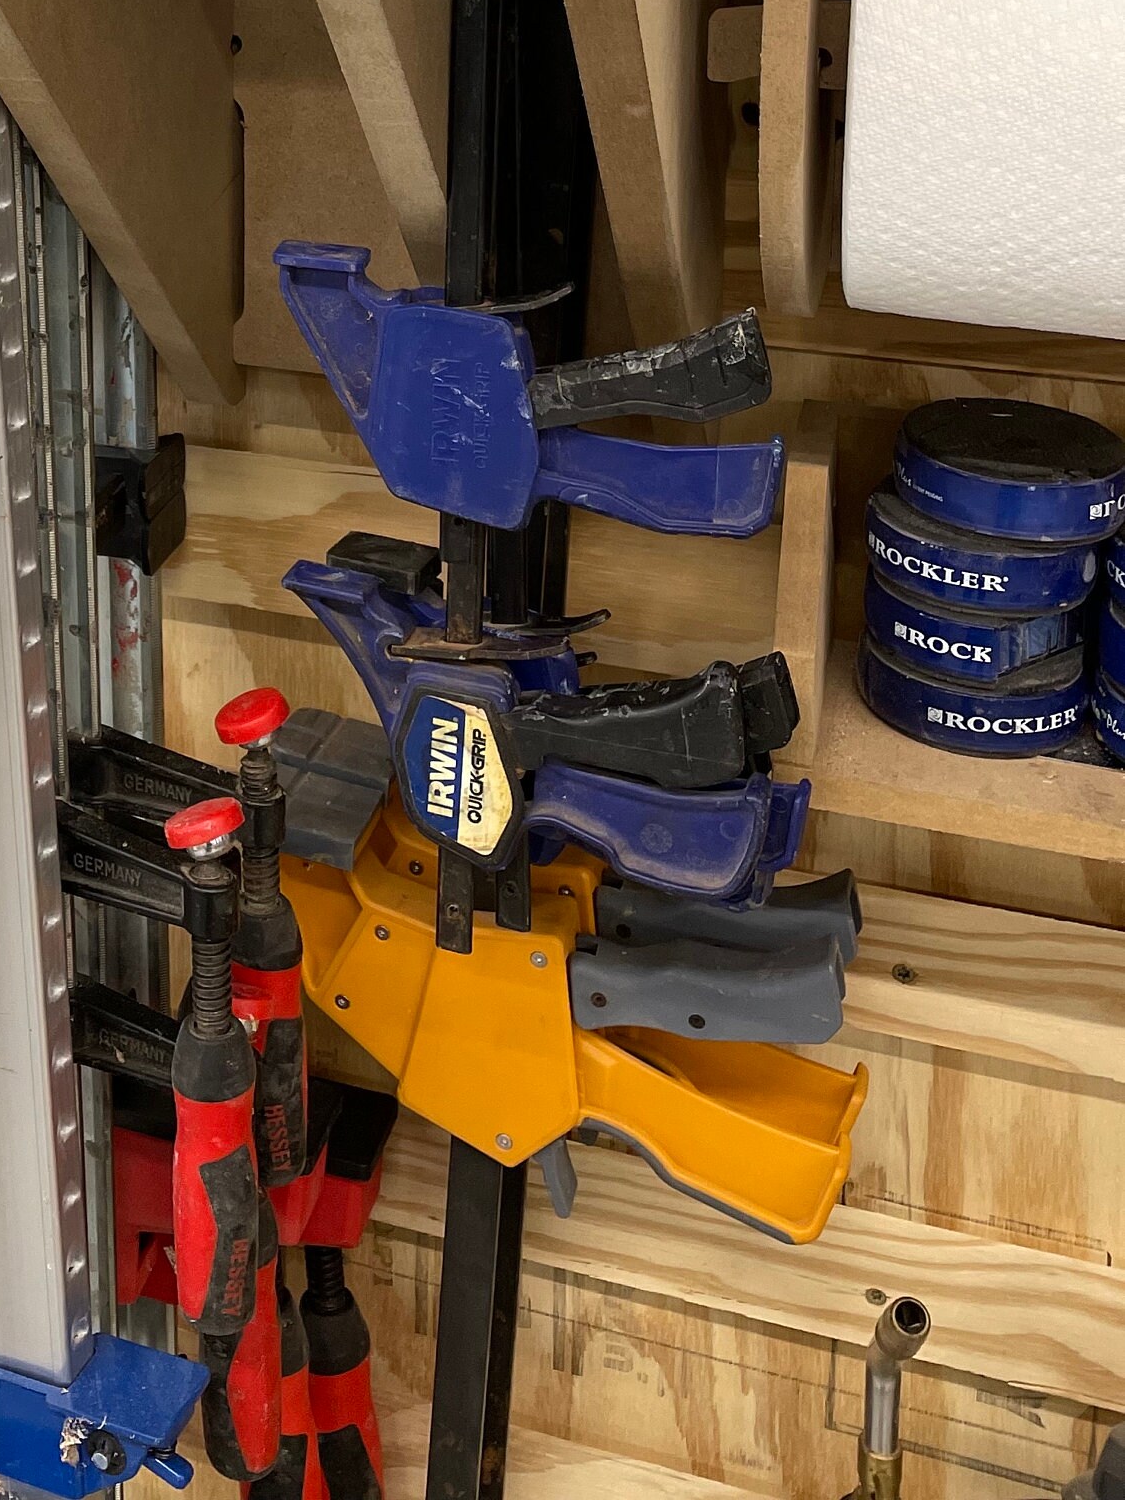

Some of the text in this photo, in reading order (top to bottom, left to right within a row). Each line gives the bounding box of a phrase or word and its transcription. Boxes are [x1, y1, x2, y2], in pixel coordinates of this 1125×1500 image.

[875, 536, 1006, 592] ROCKLER
[906, 627, 993, 663] ROCK
[945, 707, 1077, 734] ROCKLER
[123, 773, 193, 803] GERMANY
[427, 717, 458, 817] IRWIN
[467, 728, 486, 824] QUICK-GRIP
[73, 853, 141, 887] GERMANY
[264, 1104, 291, 1170] BESSEY
